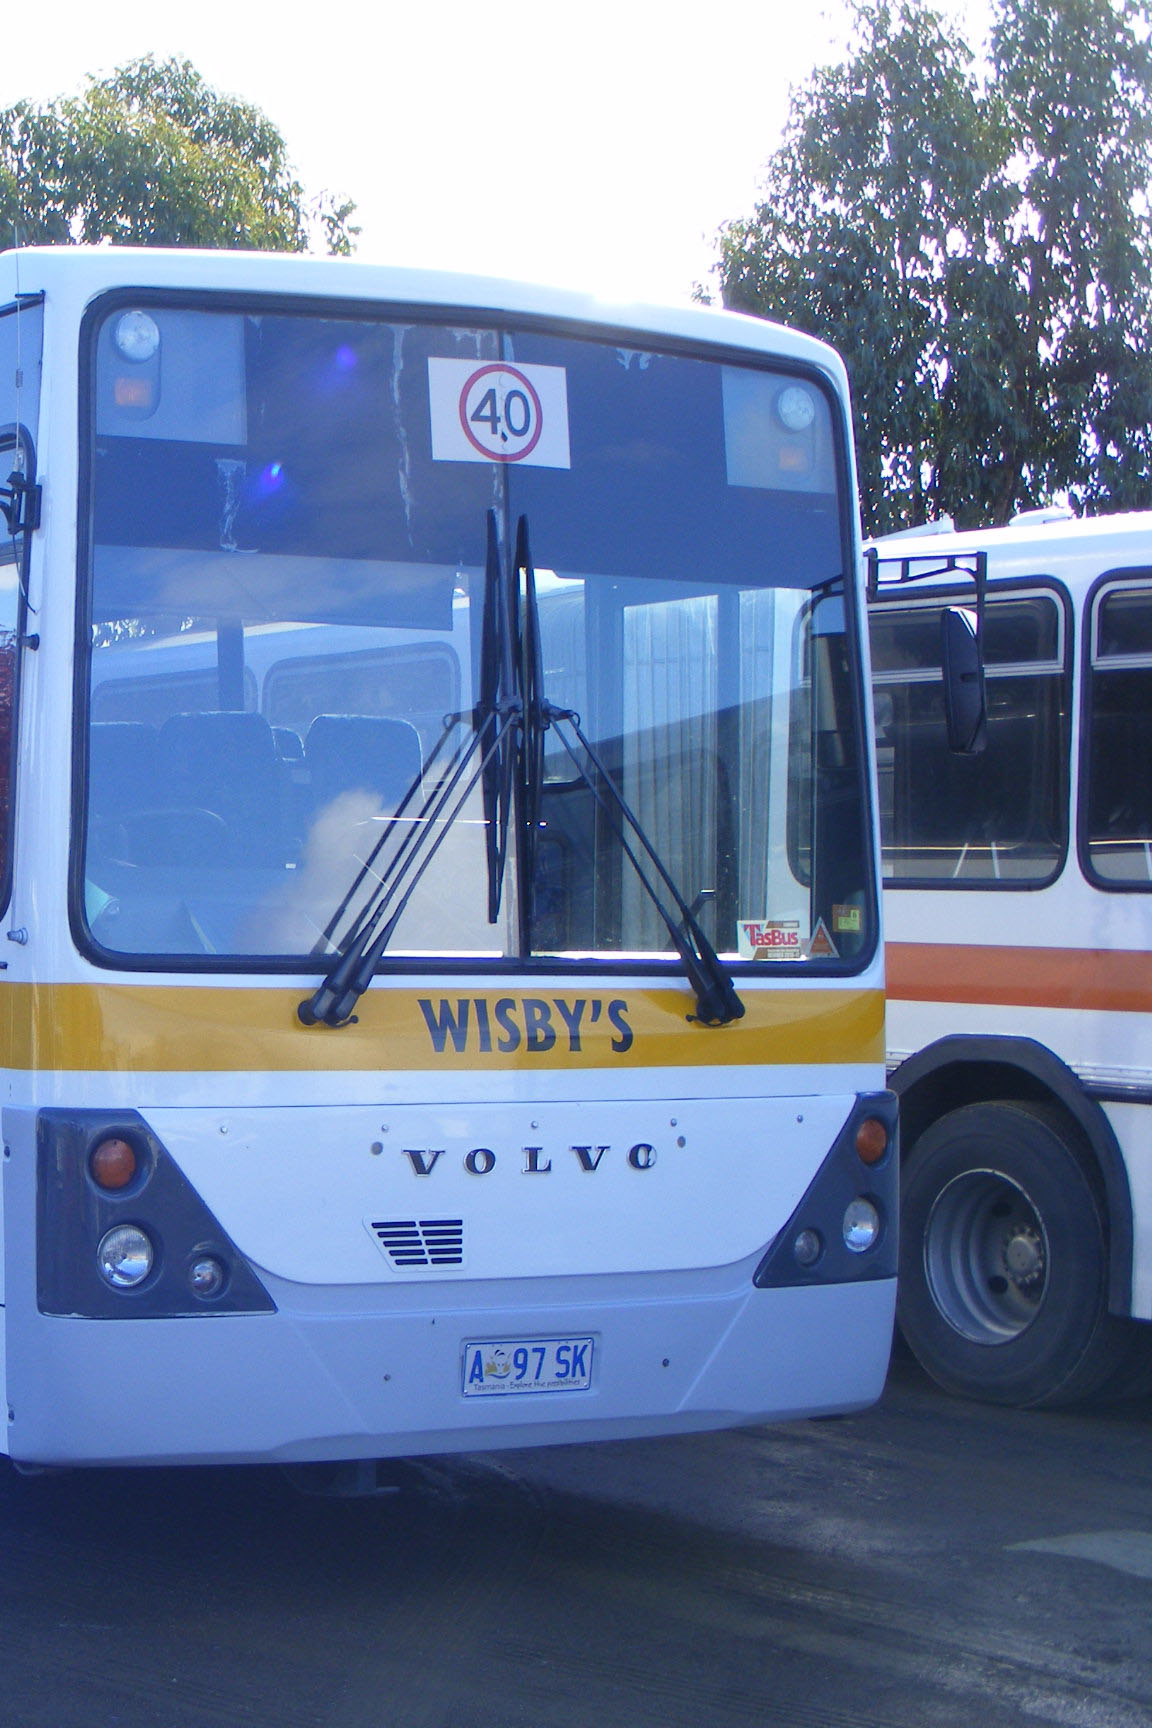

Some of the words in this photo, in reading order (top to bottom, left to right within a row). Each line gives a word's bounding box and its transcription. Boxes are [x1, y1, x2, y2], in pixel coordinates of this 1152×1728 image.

[470, 388, 531, 438] 40
[743, 924, 799, 947] TasBus
[417, 997, 634, 1053] WISBY'S
[402, 1143, 658, 1177] VOLVO
[469, 1350, 485, 1384] A
[513, 1347, 546, 1381] 97
[555, 1344, 589, 1378] SK
[474, 1382, 506, 1391] Tasmania
[509, 1380, 532, 1390] Explore
